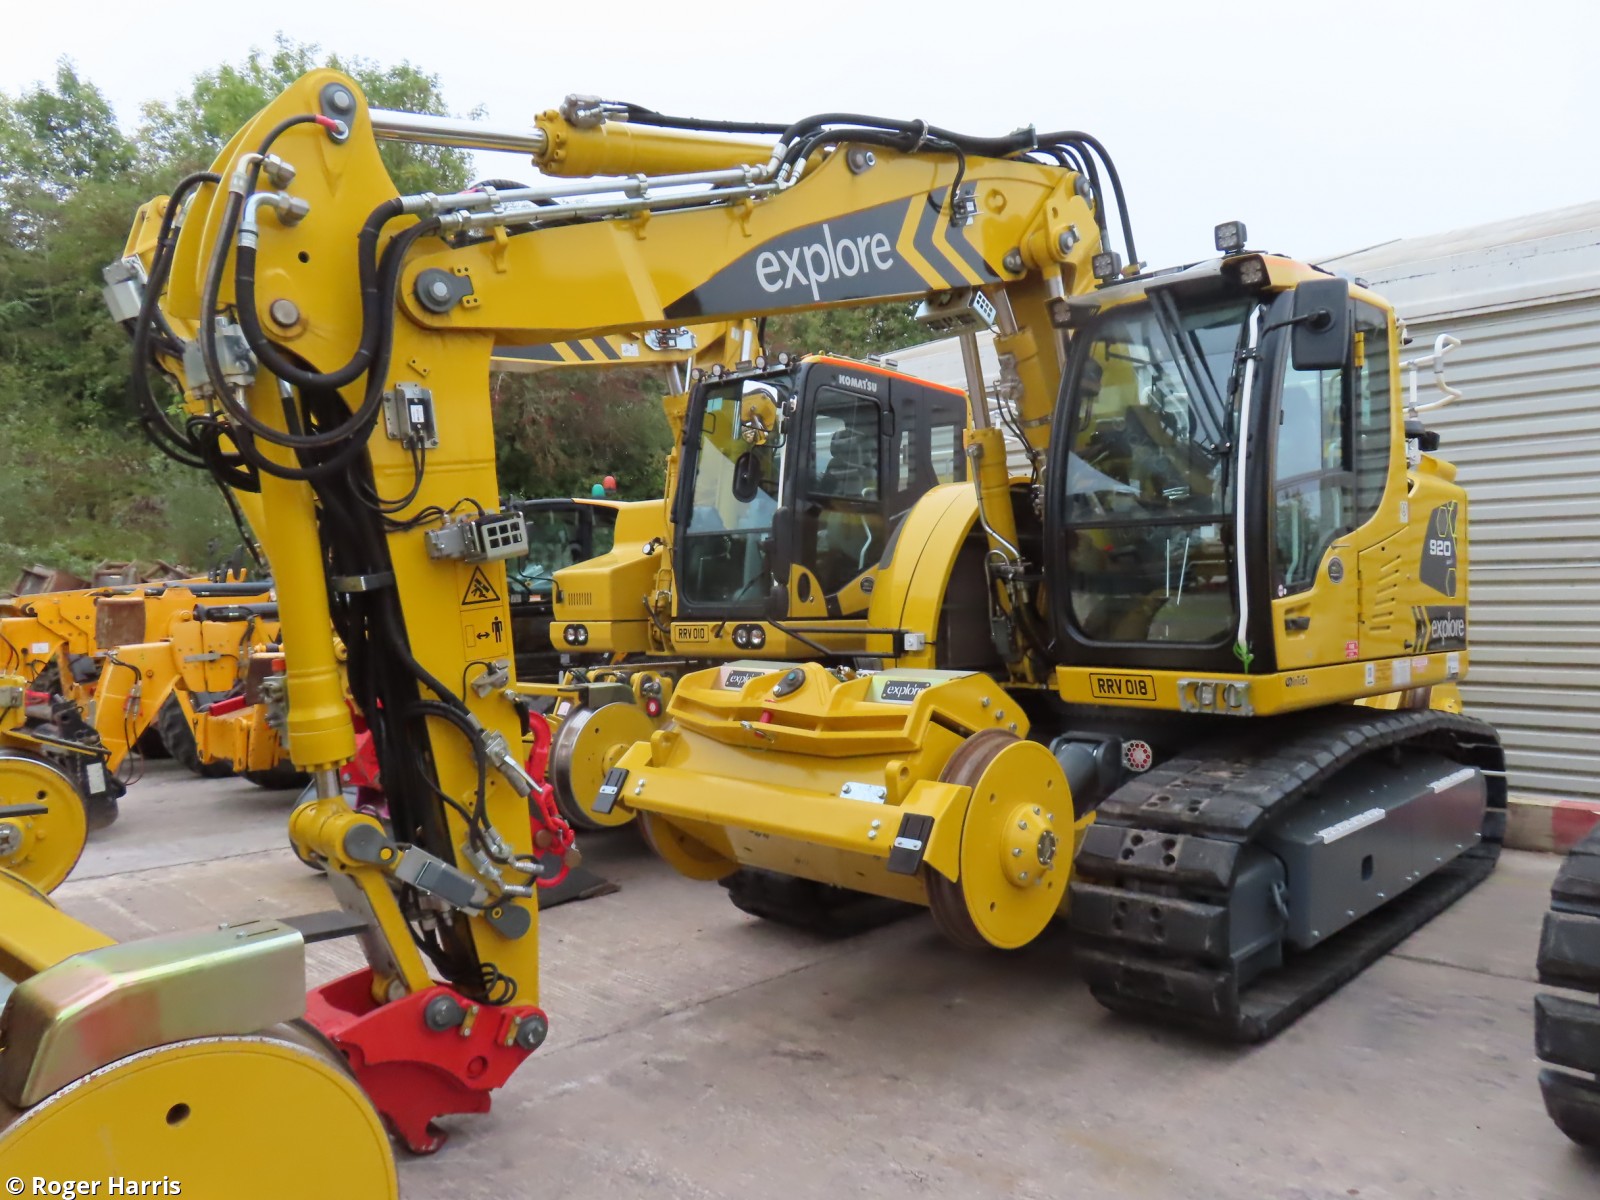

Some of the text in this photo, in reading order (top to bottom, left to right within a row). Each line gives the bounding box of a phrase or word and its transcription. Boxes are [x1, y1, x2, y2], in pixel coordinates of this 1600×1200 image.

[756, 223, 894, 301] explore
[838, 374, 878, 393] KOMATSU
[1429, 539, 1452, 557] 920
[678, 628, 705, 639] RRV 010
[1431, 611, 1465, 646] explore
[1097, 678, 1148, 695] RRV 018
